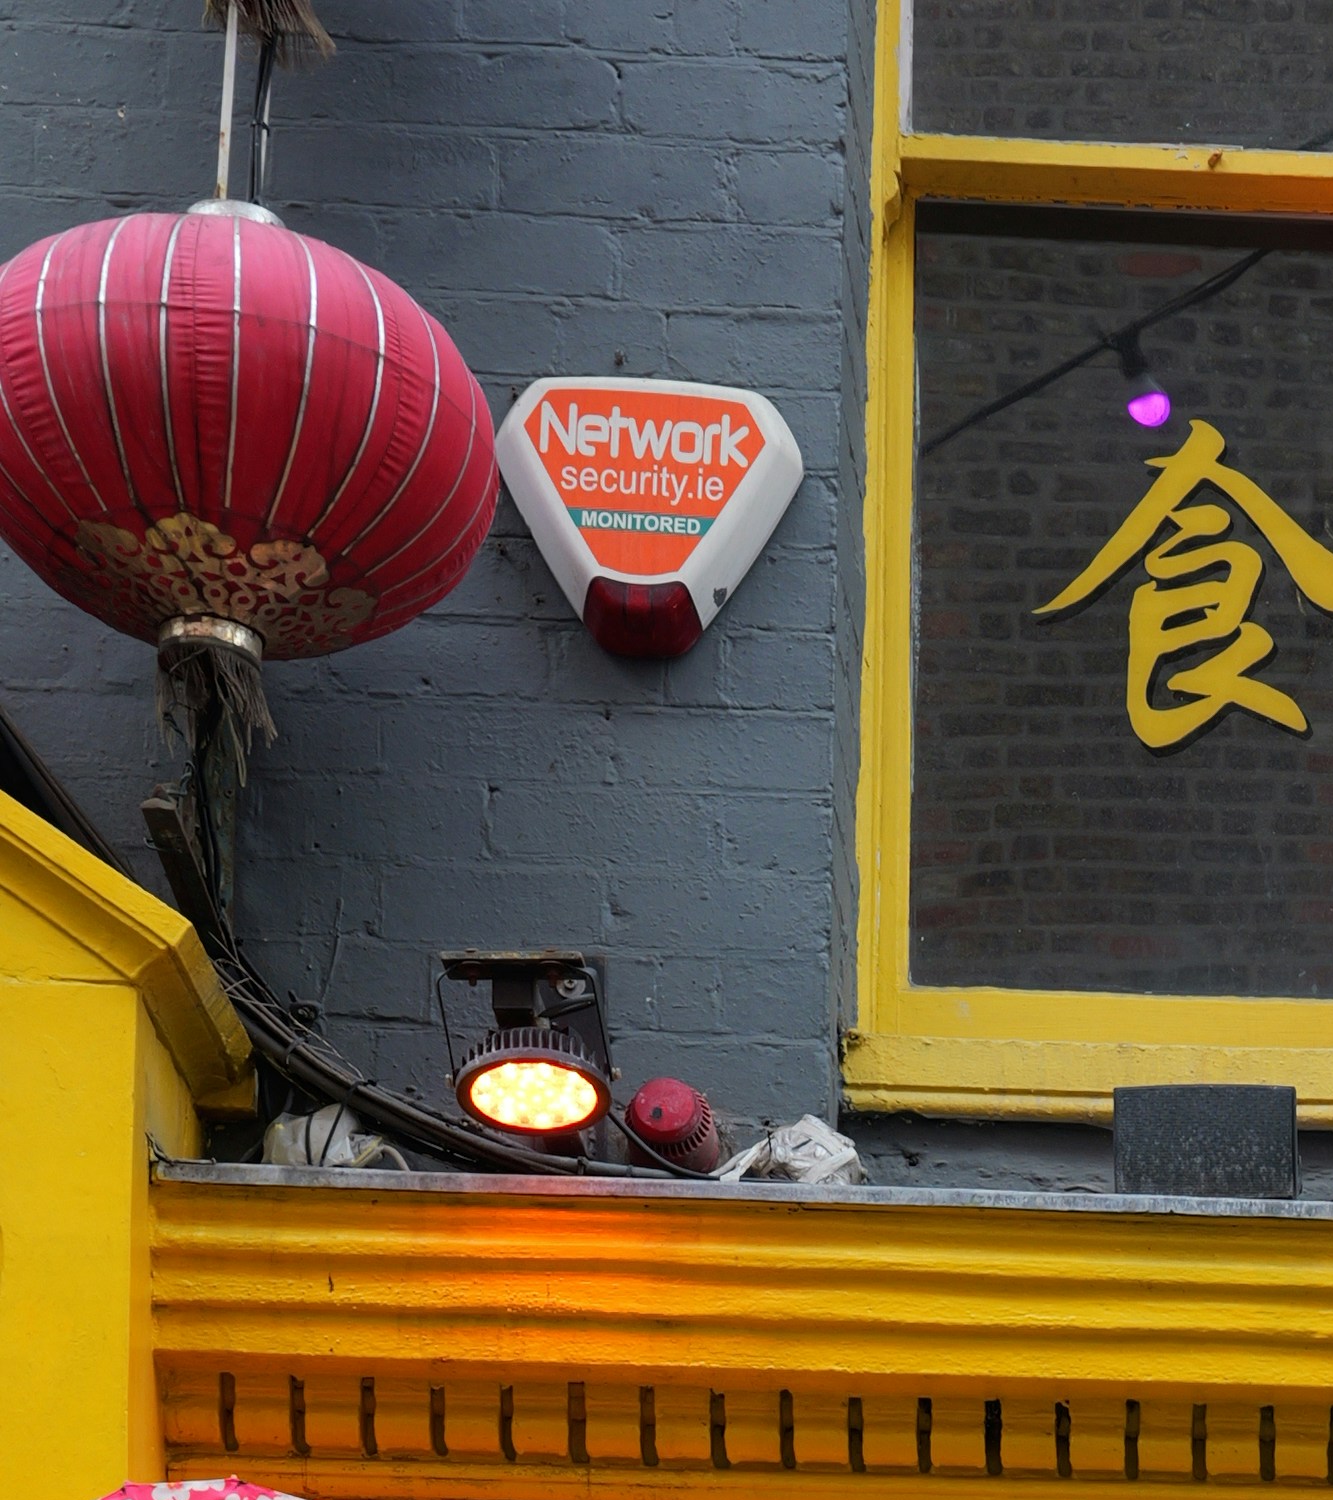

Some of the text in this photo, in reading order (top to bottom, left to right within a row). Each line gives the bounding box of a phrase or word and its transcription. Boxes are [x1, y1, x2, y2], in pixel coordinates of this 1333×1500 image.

[540, 401, 749, 468] Network
[561, 464, 724, 506] security.ie
[581, 509, 700, 535] MONITORED
